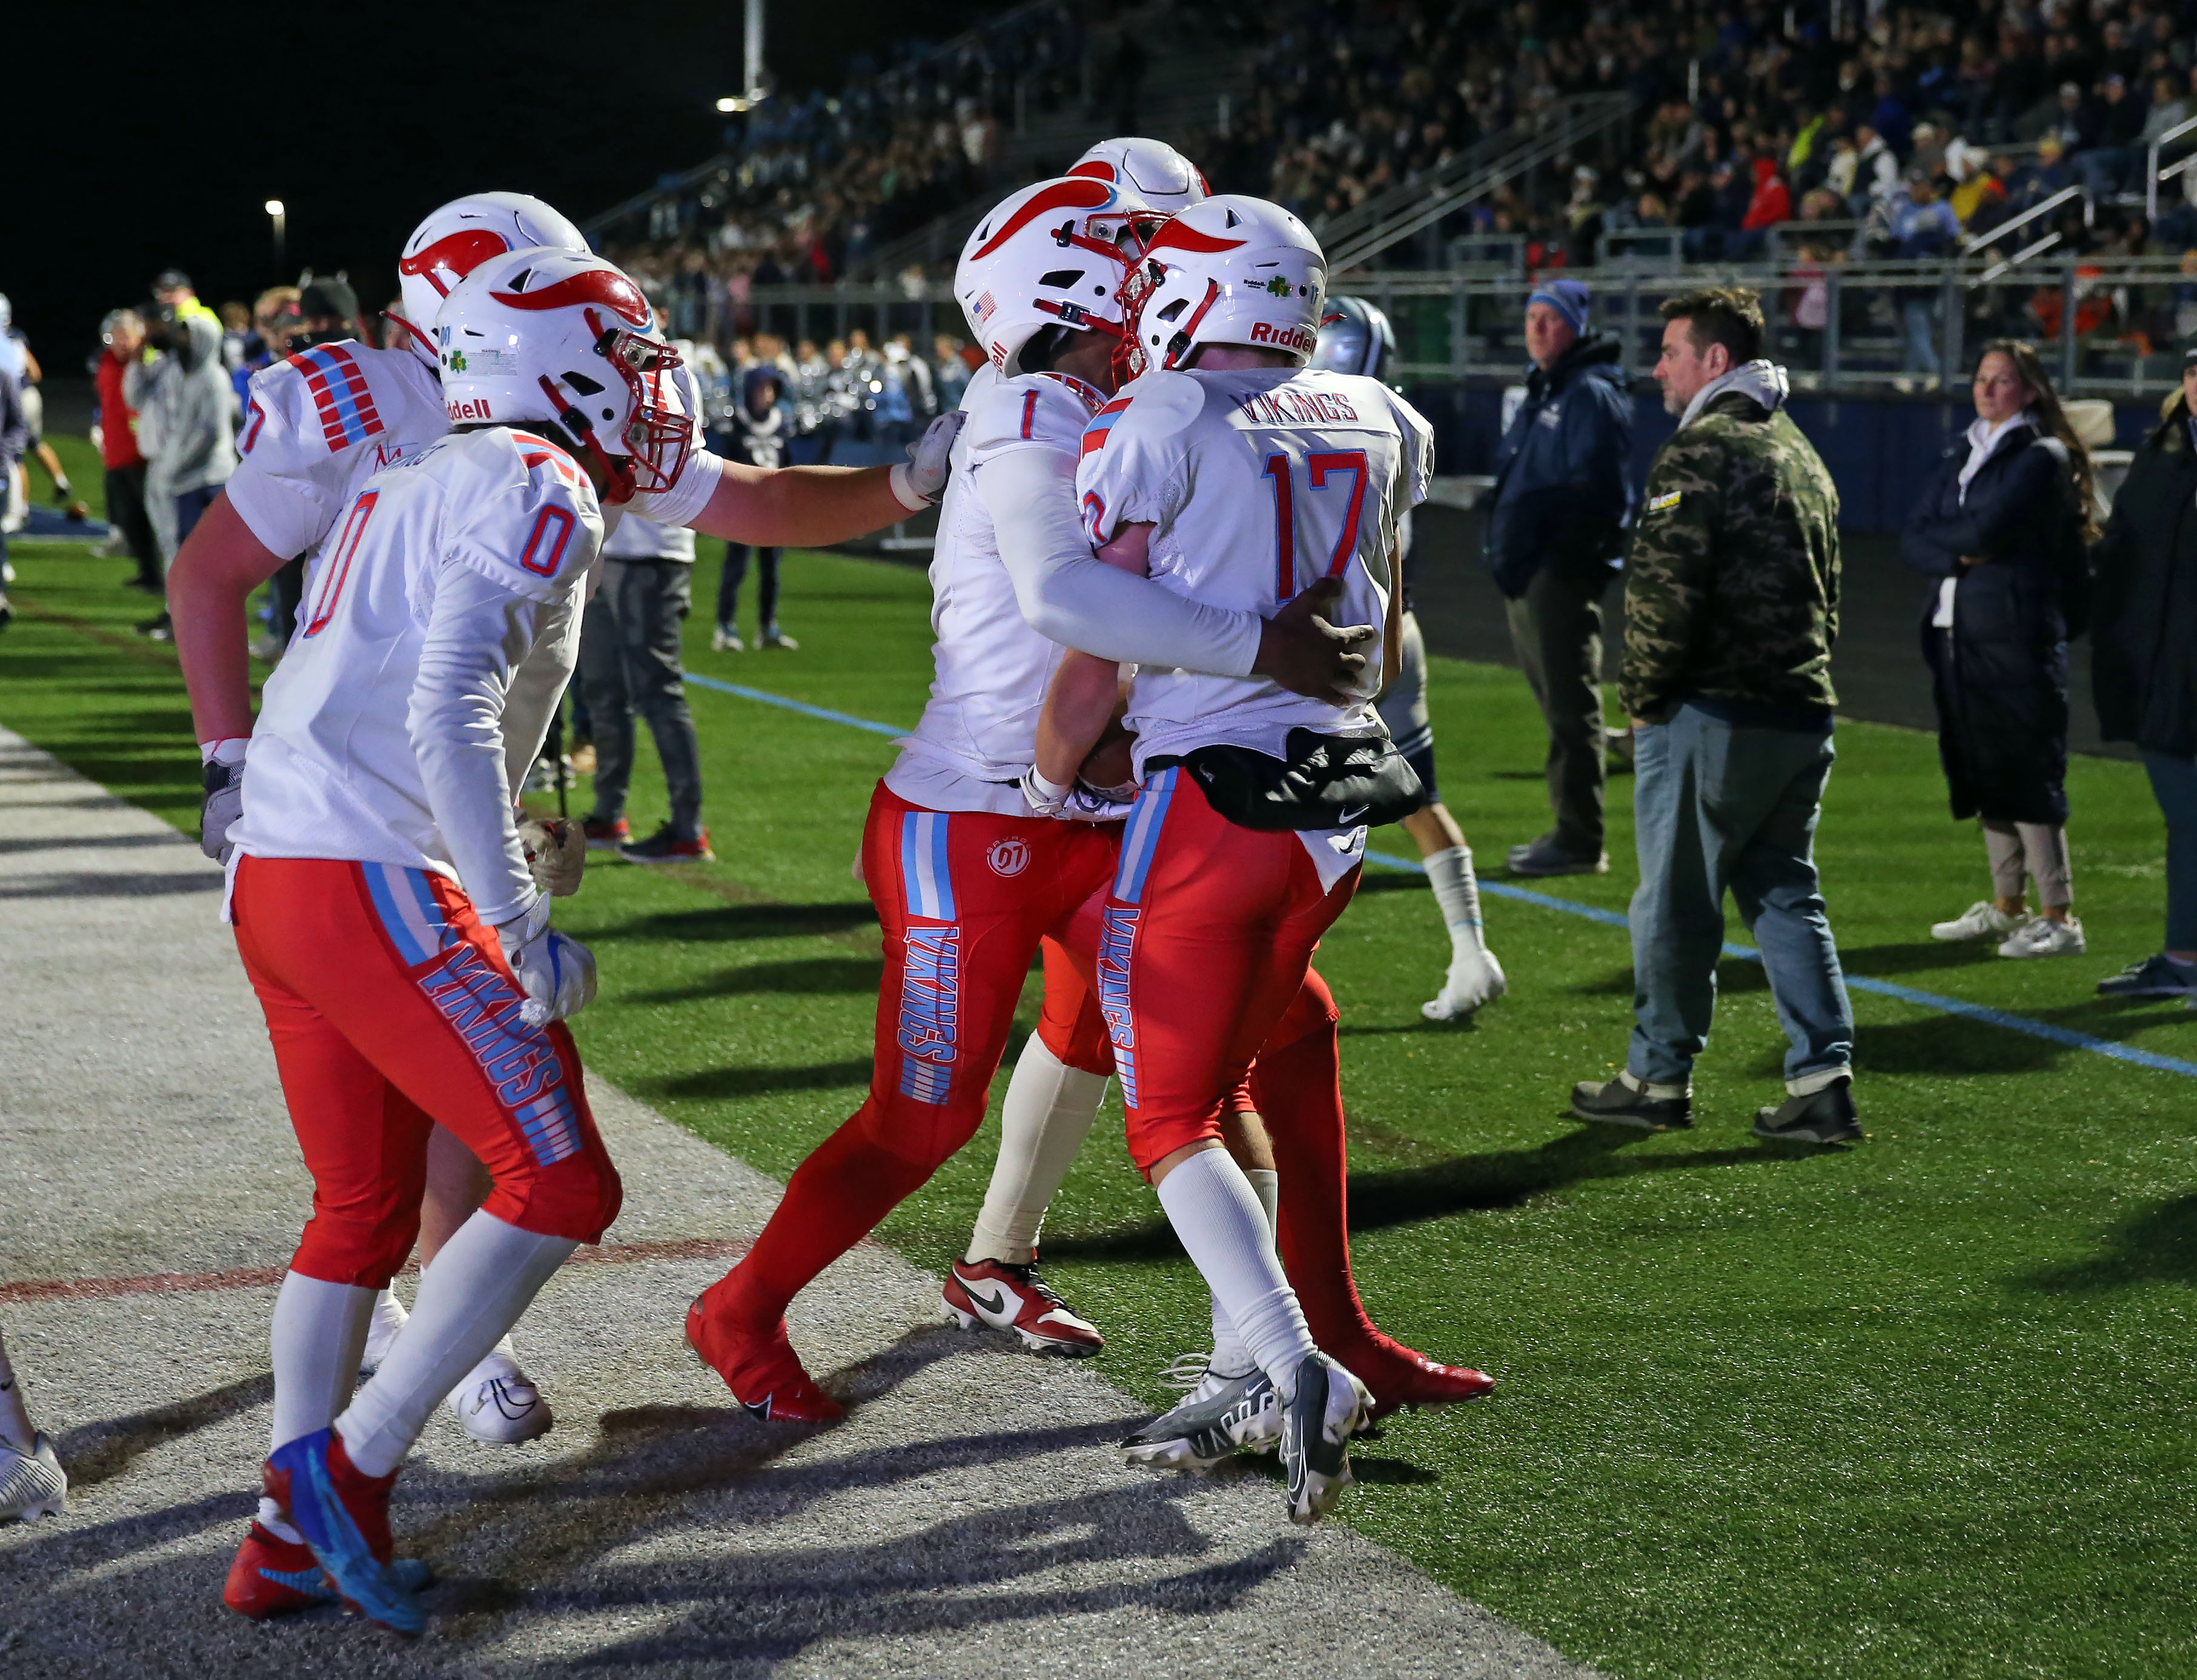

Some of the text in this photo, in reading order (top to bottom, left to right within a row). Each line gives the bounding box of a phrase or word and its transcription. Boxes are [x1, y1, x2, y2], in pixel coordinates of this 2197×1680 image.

[1250, 322, 1317, 355] Riddell
[447, 399, 491, 421] ddell
[1019, 389, 1040, 440] 1
[1228, 392, 1359, 422] VIKINGS
[303, 487, 381, 639] 0
[520, 503, 576, 577] 0
[1261, 448, 1370, 604] 17
[417, 942, 563, 1107] VIKINGS
[897, 927, 959, 1062] VIKINGS
[1096, 905, 1141, 1048] VIKINGS
